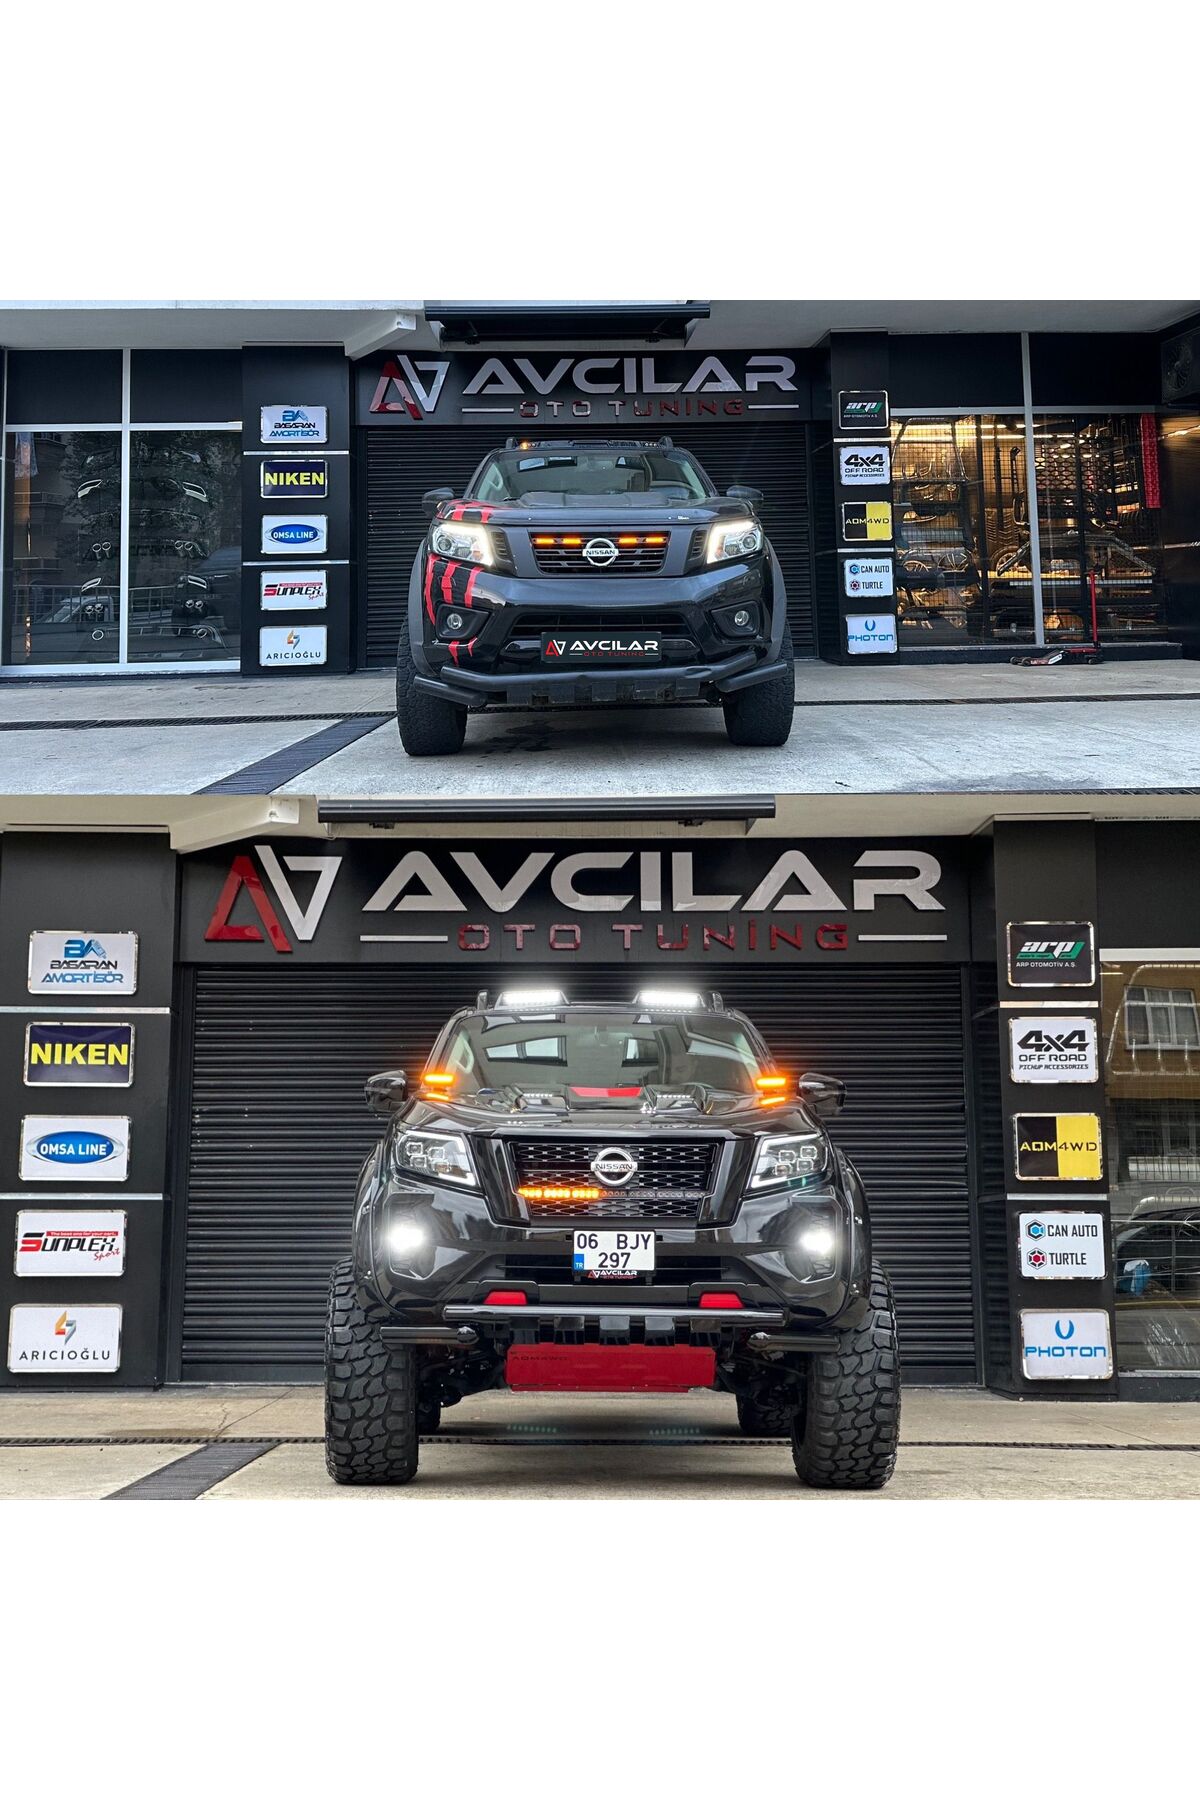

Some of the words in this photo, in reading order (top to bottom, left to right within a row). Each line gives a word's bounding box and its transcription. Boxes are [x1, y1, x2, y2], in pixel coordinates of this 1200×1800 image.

[462, 356, 798, 395] AVCILAR
[520, 401, 591, 417] OTO
[265, 472, 325, 486] NIKEN
[273, 531, 295, 539] OMSA
[296, 531, 314, 539] LINE
[860, 565, 873, 574] CAN
[874, 564, 890, 573] AUTO
[862, 581, 883, 590] TURTLE
[847, 634, 894, 642] PHOTON
[569, 640, 659, 651] AVCILAR
[266, 651, 321, 660] ARICIOĞLU
[362, 849, 947, 913] AVCILAR
[457, 923, 582, 951] OTO
[1017, 1030, 1090, 1052] 4x4
[30, 1043, 129, 1065] NIKEN
[1019, 1054, 1046, 1062] OFF
[1048, 1054, 1087, 1062] ROAD
[40, 1144, 75, 1155] OMSA
[78, 1144, 107, 1155] LINE
[1047, 1225, 1068, 1237] CAN
[1071, 1225, 1098, 1238] AUTO
[577, 1234, 598, 1249] 06
[616, 1234, 651, 1250] BJY
[93, 1248, 120, 1261] Sport
[598, 1252, 631, 1269] 297
[1050, 1253, 1087, 1265] TURTLE
[19, 1348, 110, 1360] ARICIOĞLU
[1025, 1346, 1106, 1357] PHOTON
